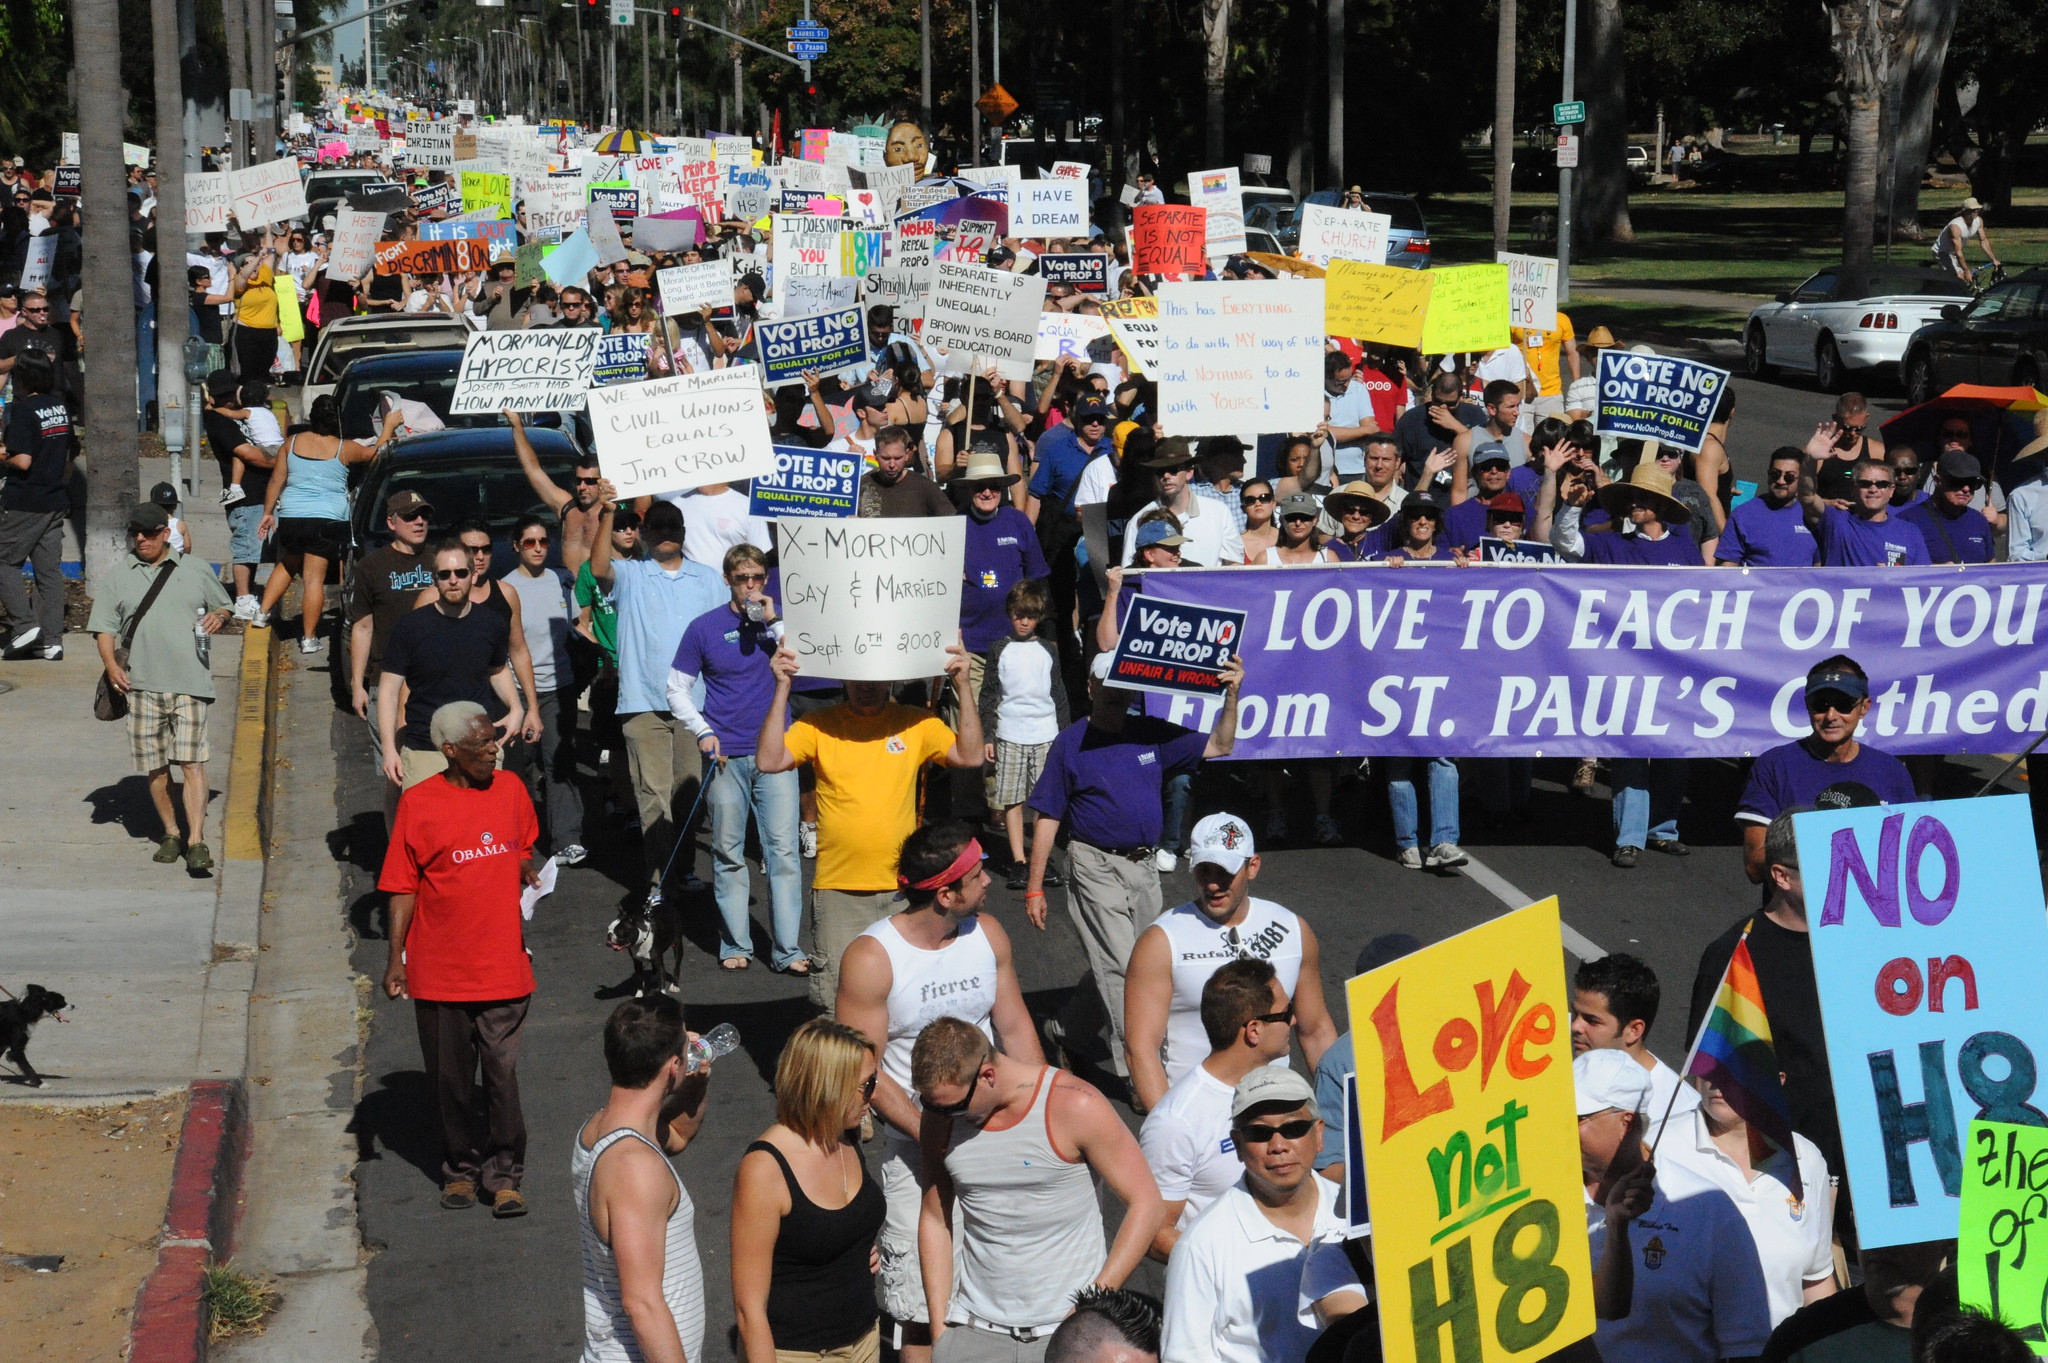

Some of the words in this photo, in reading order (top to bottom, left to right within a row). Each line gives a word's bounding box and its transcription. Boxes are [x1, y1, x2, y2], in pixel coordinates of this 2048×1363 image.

[407, 122, 432, 134] STOP
[435, 122, 450, 133] THE
[406, 137, 450, 149] CHRISTIAN
[406, 153, 451, 165] TALIBAN
[635, 157, 662, 171] LOVE
[59, 170, 80, 180] Vote
[682, 161, 706, 179] PROP
[707, 160, 717, 175] 8
[729, 165, 772, 191] Equality
[482, 173, 511, 197] LOVE
[525, 180, 569, 193] Whatever
[552, 187, 582, 199] happened
[683, 175, 720, 194] KEPT
[594, 192, 617, 201] Vote
[619, 192, 637, 201] NO
[692, 191, 715, 204] THE
[784, 193, 807, 201] Vote
[1017, 192, 1021, 202] I
[1032, 190, 1073, 202] HAVE
[531, 210, 556, 229] FREE
[803, 217, 826, 233] DOES
[961, 220, 995, 234] SUPPORT
[1015, 215, 1024, 224] A
[1032, 213, 1079, 225] DREAM
[1139, 210, 1204, 227] SEPARATE
[429, 224, 443, 240] it
[452, 223, 468, 240] is
[790, 233, 835, 249] AFFECT
[1144, 230, 1158, 243] IS
[1166, 230, 1198, 246] NOT
[1321, 229, 1377, 250] CHURCH
[375, 241, 408, 266] FIGHT
[901, 239, 929, 252] REPEAL
[387, 240, 491, 274] DISCRIMIN8ION
[798, 249, 825, 263] YOU
[1045, 260, 1077, 271] Vote
[1080, 259, 1103, 271] NO
[1138, 246, 1205, 268] EQUAL!
[732, 257, 764, 275] Kids
[790, 263, 810, 276] BUT
[816, 264, 828, 276] IT
[939, 264, 998, 283] SEPARATE
[1013, 276, 1025, 287] IS
[1063, 271, 1093, 280] PROP
[1095, 271, 1103, 280] 8
[938, 279, 1012, 301] INHERENTLY
[1512, 282, 1548, 299] AGAINST
[1164, 299, 1188, 316] This
[1196, 301, 1216, 316] has
[1512, 297, 1534, 324] H8
[762, 320, 820, 343] VOTE
[824, 310, 859, 333] NO
[930, 319, 970, 335] BROWN
[974, 327, 990, 338] VS.
[993, 329, 1033, 344] BOARD
[627, 334, 652, 350] NO
[767, 341, 796, 358] ON
[801, 332, 845, 353] PROP
[850, 328, 860, 341] 8
[926, 334, 943, 345] OF
[947, 338, 1012, 357] EDUCATION
[1163, 335, 1179, 349] to
[1185, 335, 1199, 349] do
[1204, 336, 1230, 349] with
[1235, 332, 1256, 349] MY
[1261, 337, 1283, 353] way
[1286, 335, 1297, 348] of
[1304, 335, 1322, 348] life
[610, 351, 641, 364] PROP
[769, 356, 819, 371] EQUALITY
[821, 350, 842, 362] FOR
[844, 346, 862, 356] ALL
[1163, 369, 1188, 382] and
[1265, 365, 1279, 378] to
[1285, 367, 1300, 378] do
[1606, 355, 1676, 385] VOTE
[1679, 366, 1721, 396] NO
[461, 380, 504, 394] Joseph
[546, 379, 570, 389] HAD
[454, 396, 492, 410] HOW
[498, 395, 545, 410] MANY
[1167, 399, 1198, 414] with
[1604, 379, 1639, 400] ON
[1645, 385, 1695, 410] PROP
[1697, 397, 1711, 415] 8
[611, 410, 668, 432] CIVIL
[1602, 405, 1658, 421] EQUALITY
[1660, 414, 1683, 427] FOR
[1684, 419, 1700, 433] ALL
[646, 422, 734, 449] EQUALS
[1613, 420, 1686, 442] www.NoOnProp8.com
[820, 458, 855, 478] NO
[758, 473, 787, 488] ON
[792, 474, 837, 491] PROP
[842, 479, 853, 494] 8
[756, 491, 806, 503] EQUALITY
[809, 496, 830, 505] FOR
[832, 498, 851, 507] ALL
[768, 505, 838, 518] www.NoOnProp8.com
[1489, 546, 1537, 563] Vote
[1140, 607, 1192, 639] Vote
[1197, 617, 1236, 646] NO
[1263, 587, 1432, 652] LOVE
[1461, 587, 1545, 651] TO
[1567, 588, 1755, 651] EACH
[1778, 588, 1872, 651] OF
[1900, 583, 2048, 649] YOU
[897, 631, 943, 653] 2008
[1129, 638, 1155, 654] on
[1159, 639, 1212, 663] PROP
[1216, 647, 1230, 666] 8
[1118, 660, 1163, 679] UNFAIR
[1164, 668, 1174, 681] &
[1361, 674, 1454, 738] ST.
[1490, 674, 1736, 739] PAUL'S
[1769, 673, 2048, 739] Cthed
[452, 843, 509, 863] OBAMA
[1819, 812, 1960, 927] NO
[920, 976, 981, 1003] fierce
[1874, 954, 1978, 1016] on
[1866, 1030, 2048, 1208] H8
[1426, 1098, 1529, 1221] not
[1988, 1193, 2048, 1271] of
[1408, 1199, 1570, 1363] H8
